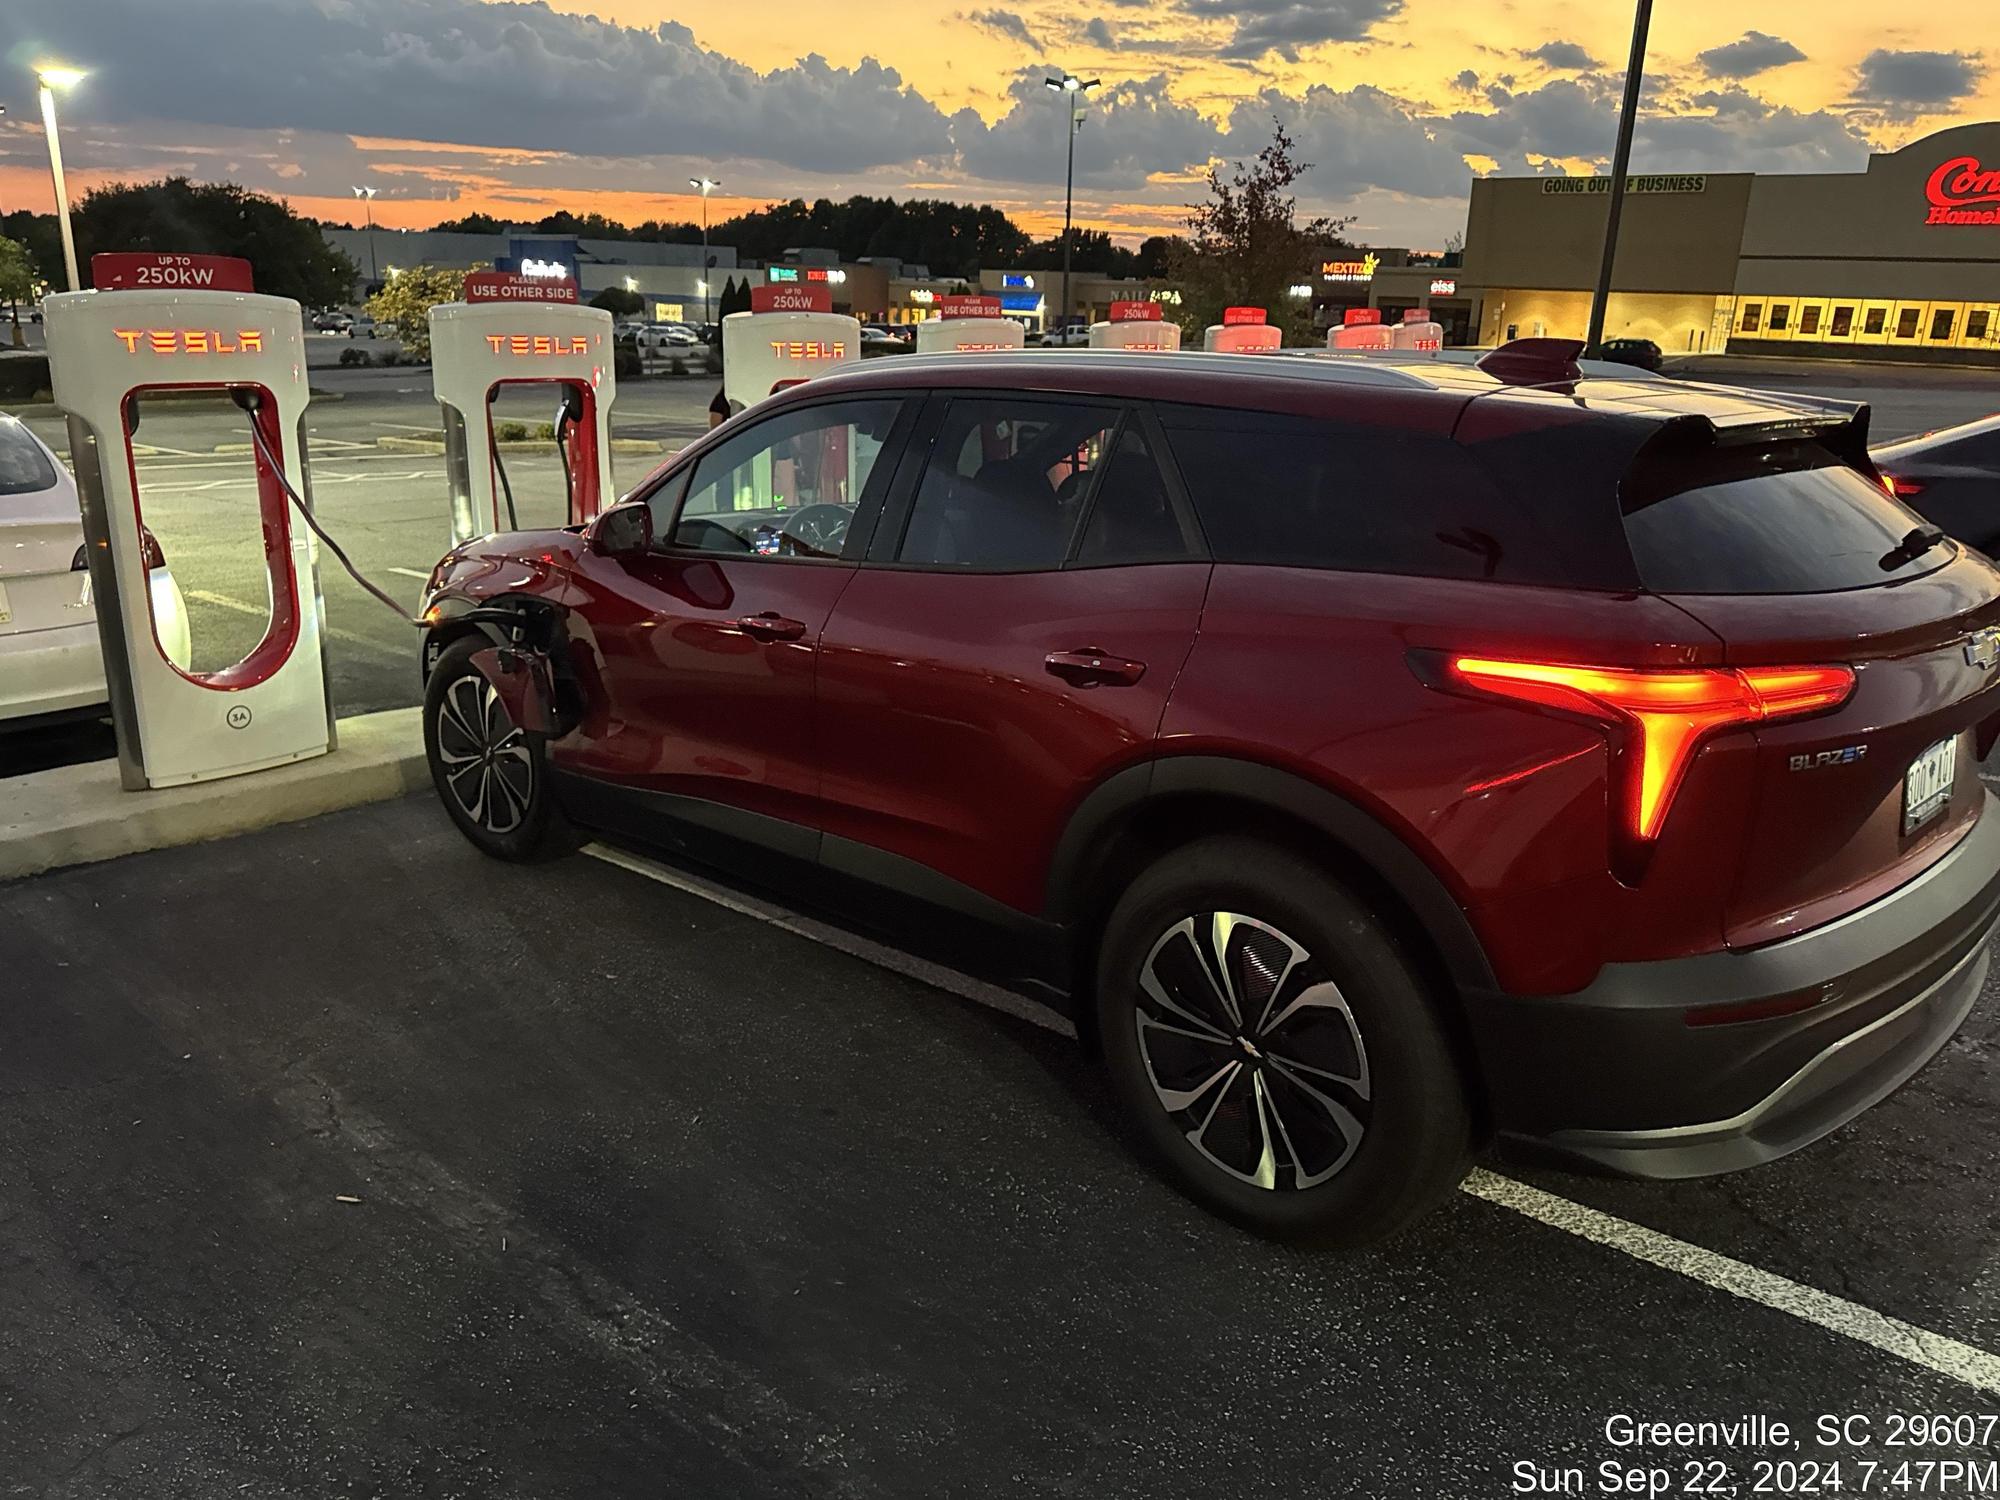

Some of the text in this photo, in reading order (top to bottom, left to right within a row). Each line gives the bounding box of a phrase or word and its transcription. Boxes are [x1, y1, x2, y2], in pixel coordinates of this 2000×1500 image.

[1544, 179, 1584, 193] GOING
[1636, 176, 1704, 191] BUSINESS
[158, 257, 190, 266] UP TO
[1323, 261, 1375, 275] MEXTIZO
[137, 267, 214, 284] 250kW
[509, 276, 537, 284] PLEASE
[473, 285, 574, 299] USE OTHER SIDE
[773, 296, 813, 308] 250kW
[944, 306, 1000, 315] USE OTHER SIDE
[1124, 309, 1150, 319] 250kW
[112, 329, 263, 353] TESLA
[486, 335, 588, 354] TESLA
[769, 342, 845, 358] TESLA
[232, 712, 247, 722] 3A
[1790, 745, 1868, 771] BLAZER
